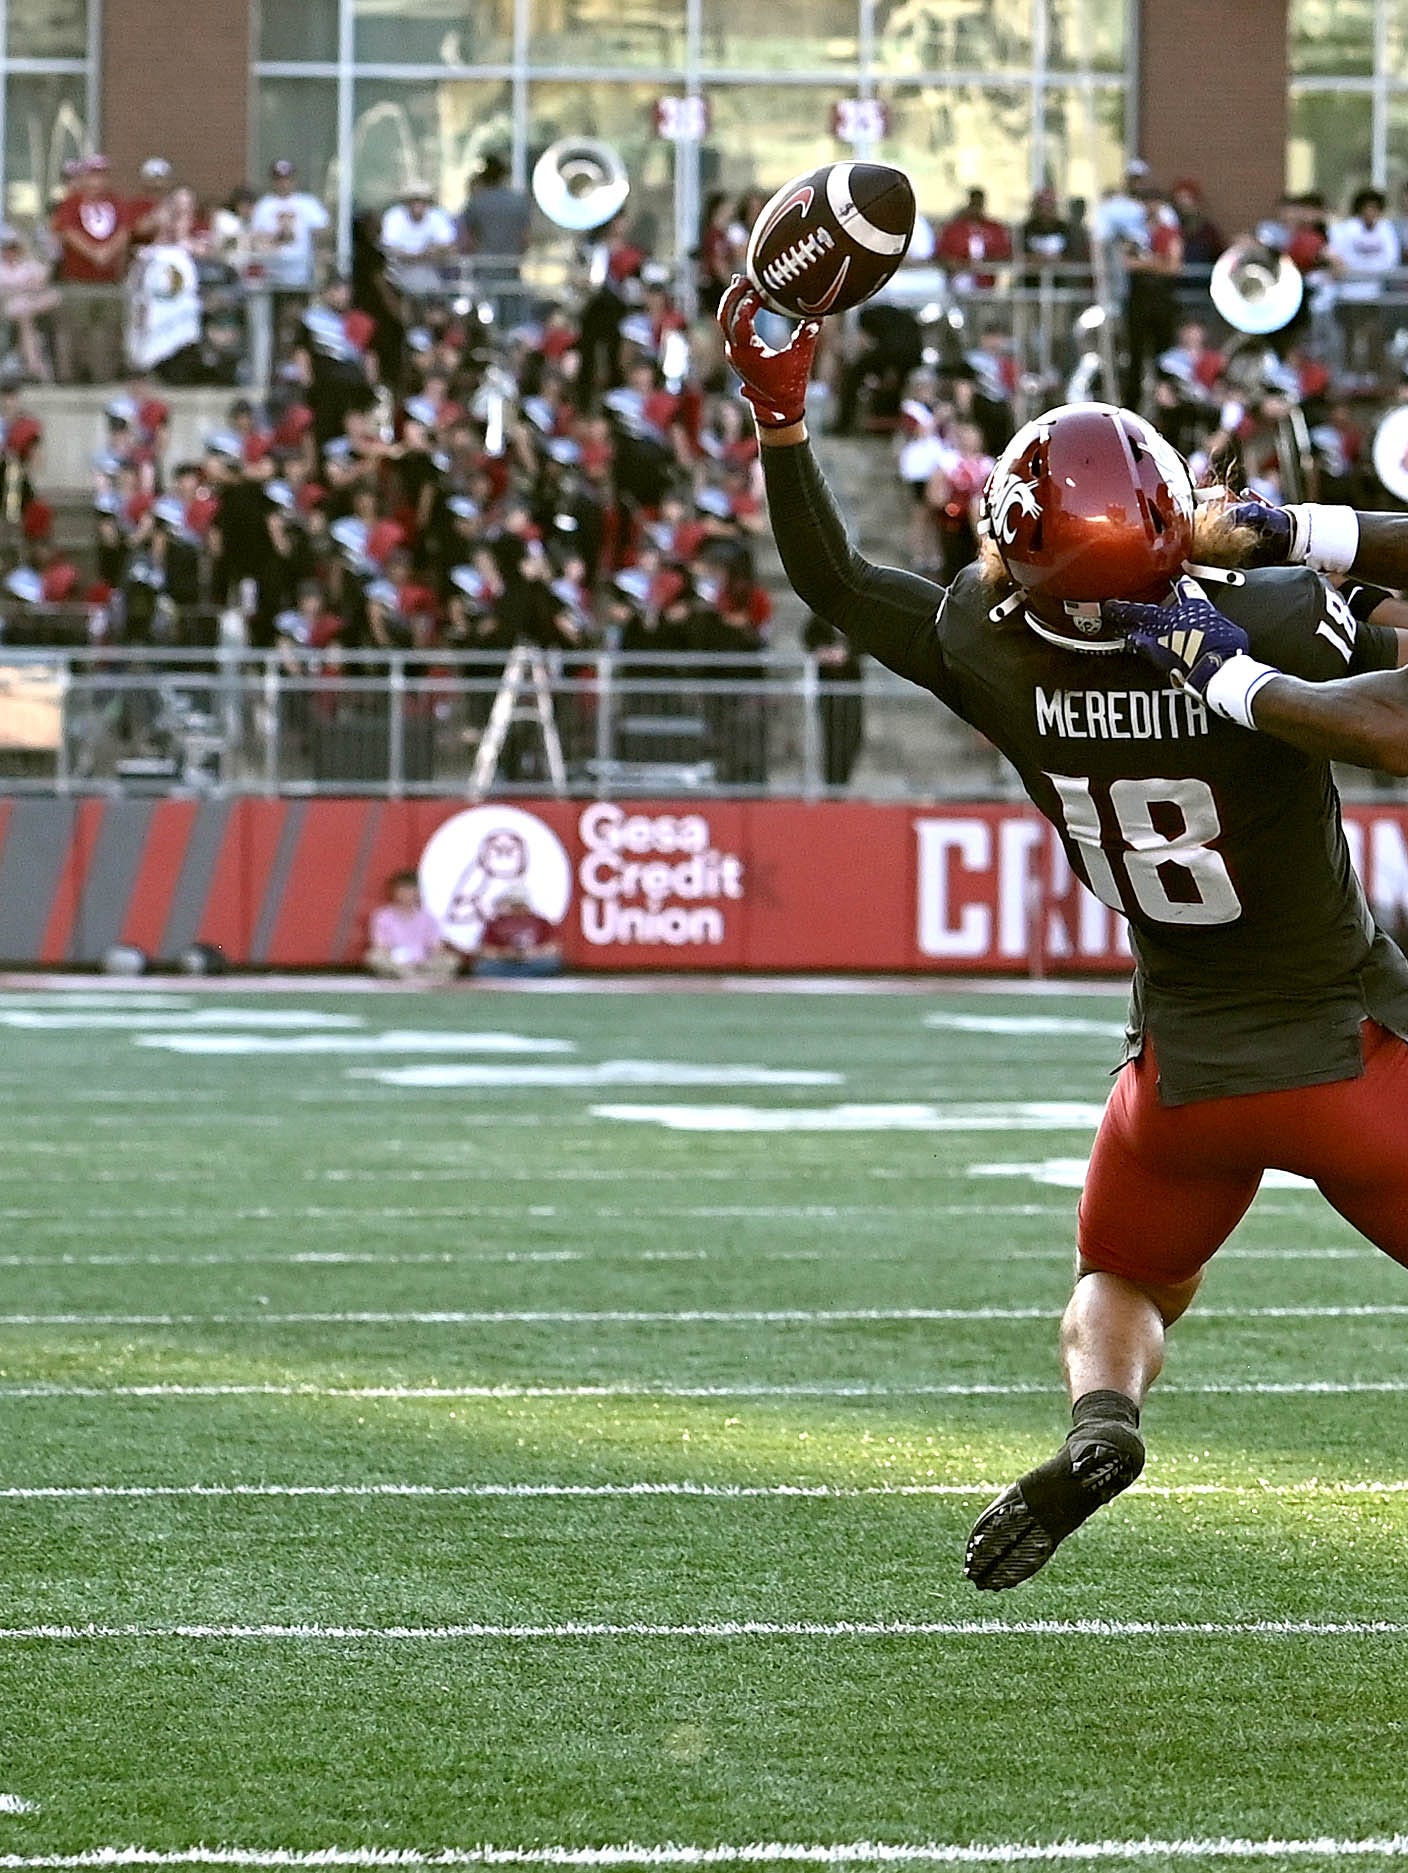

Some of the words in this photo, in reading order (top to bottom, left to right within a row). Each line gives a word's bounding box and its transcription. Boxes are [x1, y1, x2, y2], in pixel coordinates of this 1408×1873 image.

[1314, 584, 1357, 665] 18
[1035, 686, 1209, 740] MEREDITH
[578, 802, 710, 853] Gesa
[1041, 770, 1243, 925] 18
[578, 849, 744, 908] Credit
[579, 896, 725, 945] Union
